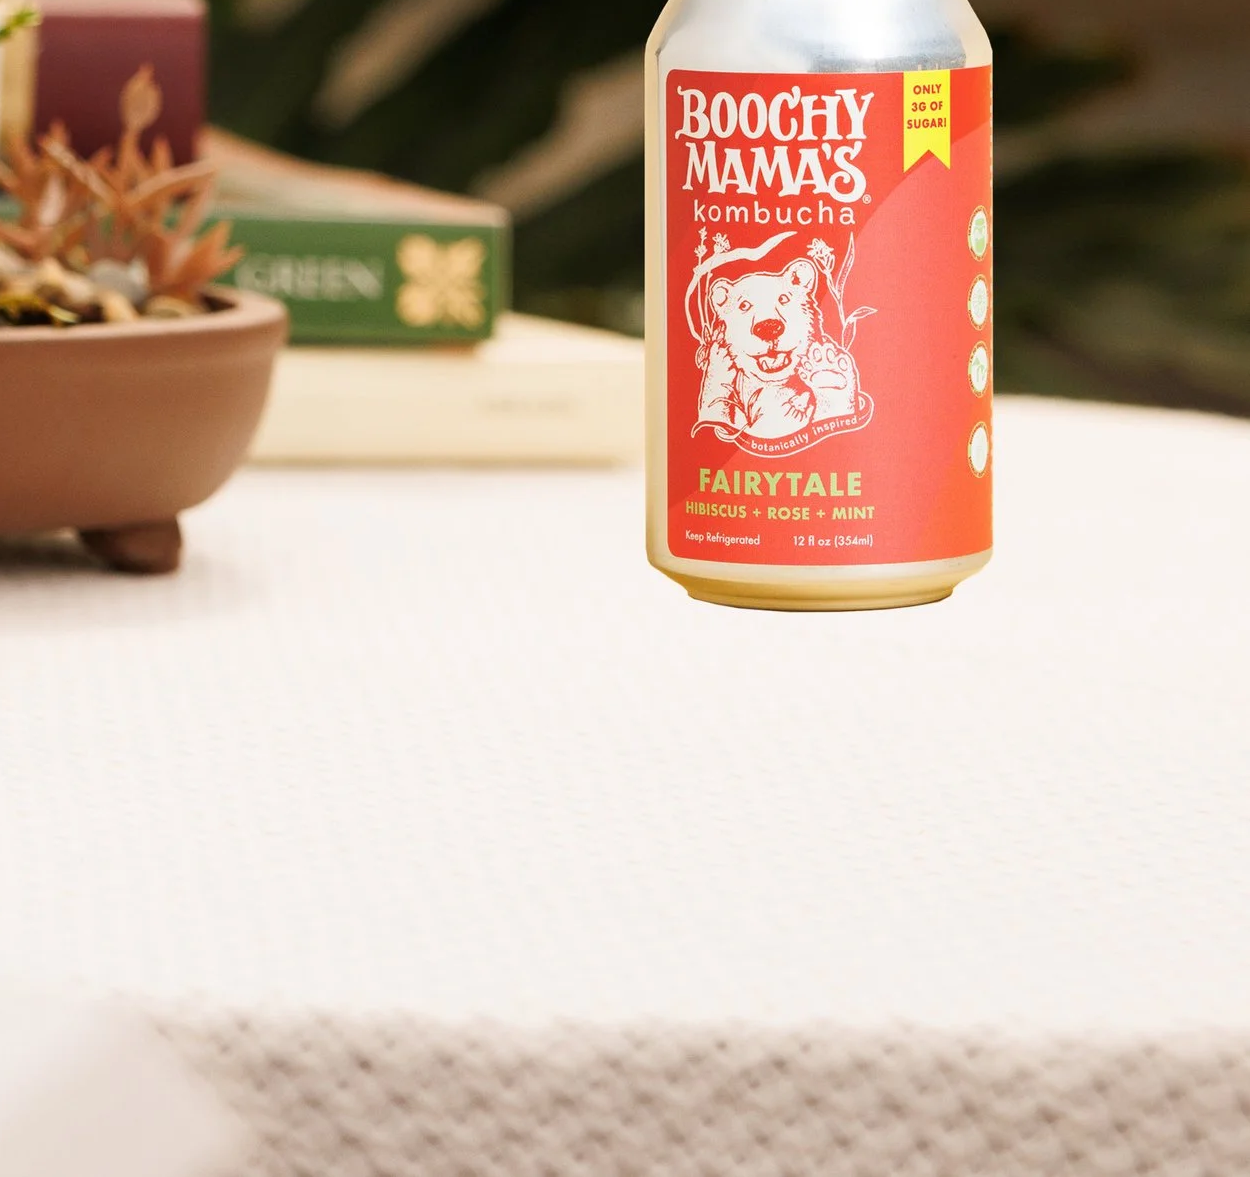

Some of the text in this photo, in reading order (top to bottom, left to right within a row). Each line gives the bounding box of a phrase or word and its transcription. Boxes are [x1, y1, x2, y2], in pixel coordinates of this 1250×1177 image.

[913, 83, 942, 95] ONLY
[675, 85, 874, 142] BOOCHY
[911, 101, 943, 112] 3G OF
[694, 200, 856, 225] kombucha
[235, 252, 386, 302] GREEN
[751, 415, 858, 452] botanically inspired
[699, 468, 862, 497] FAIRYTALE
[686, 501, 747, 519] HIBISCUS
[768, 507, 810, 520] ROSE
[832, 506, 875, 520] MINT
[685, 530, 761, 546] Keep Refrigerated
[793, 534, 874, 548] 12 fl oz (354ml)
